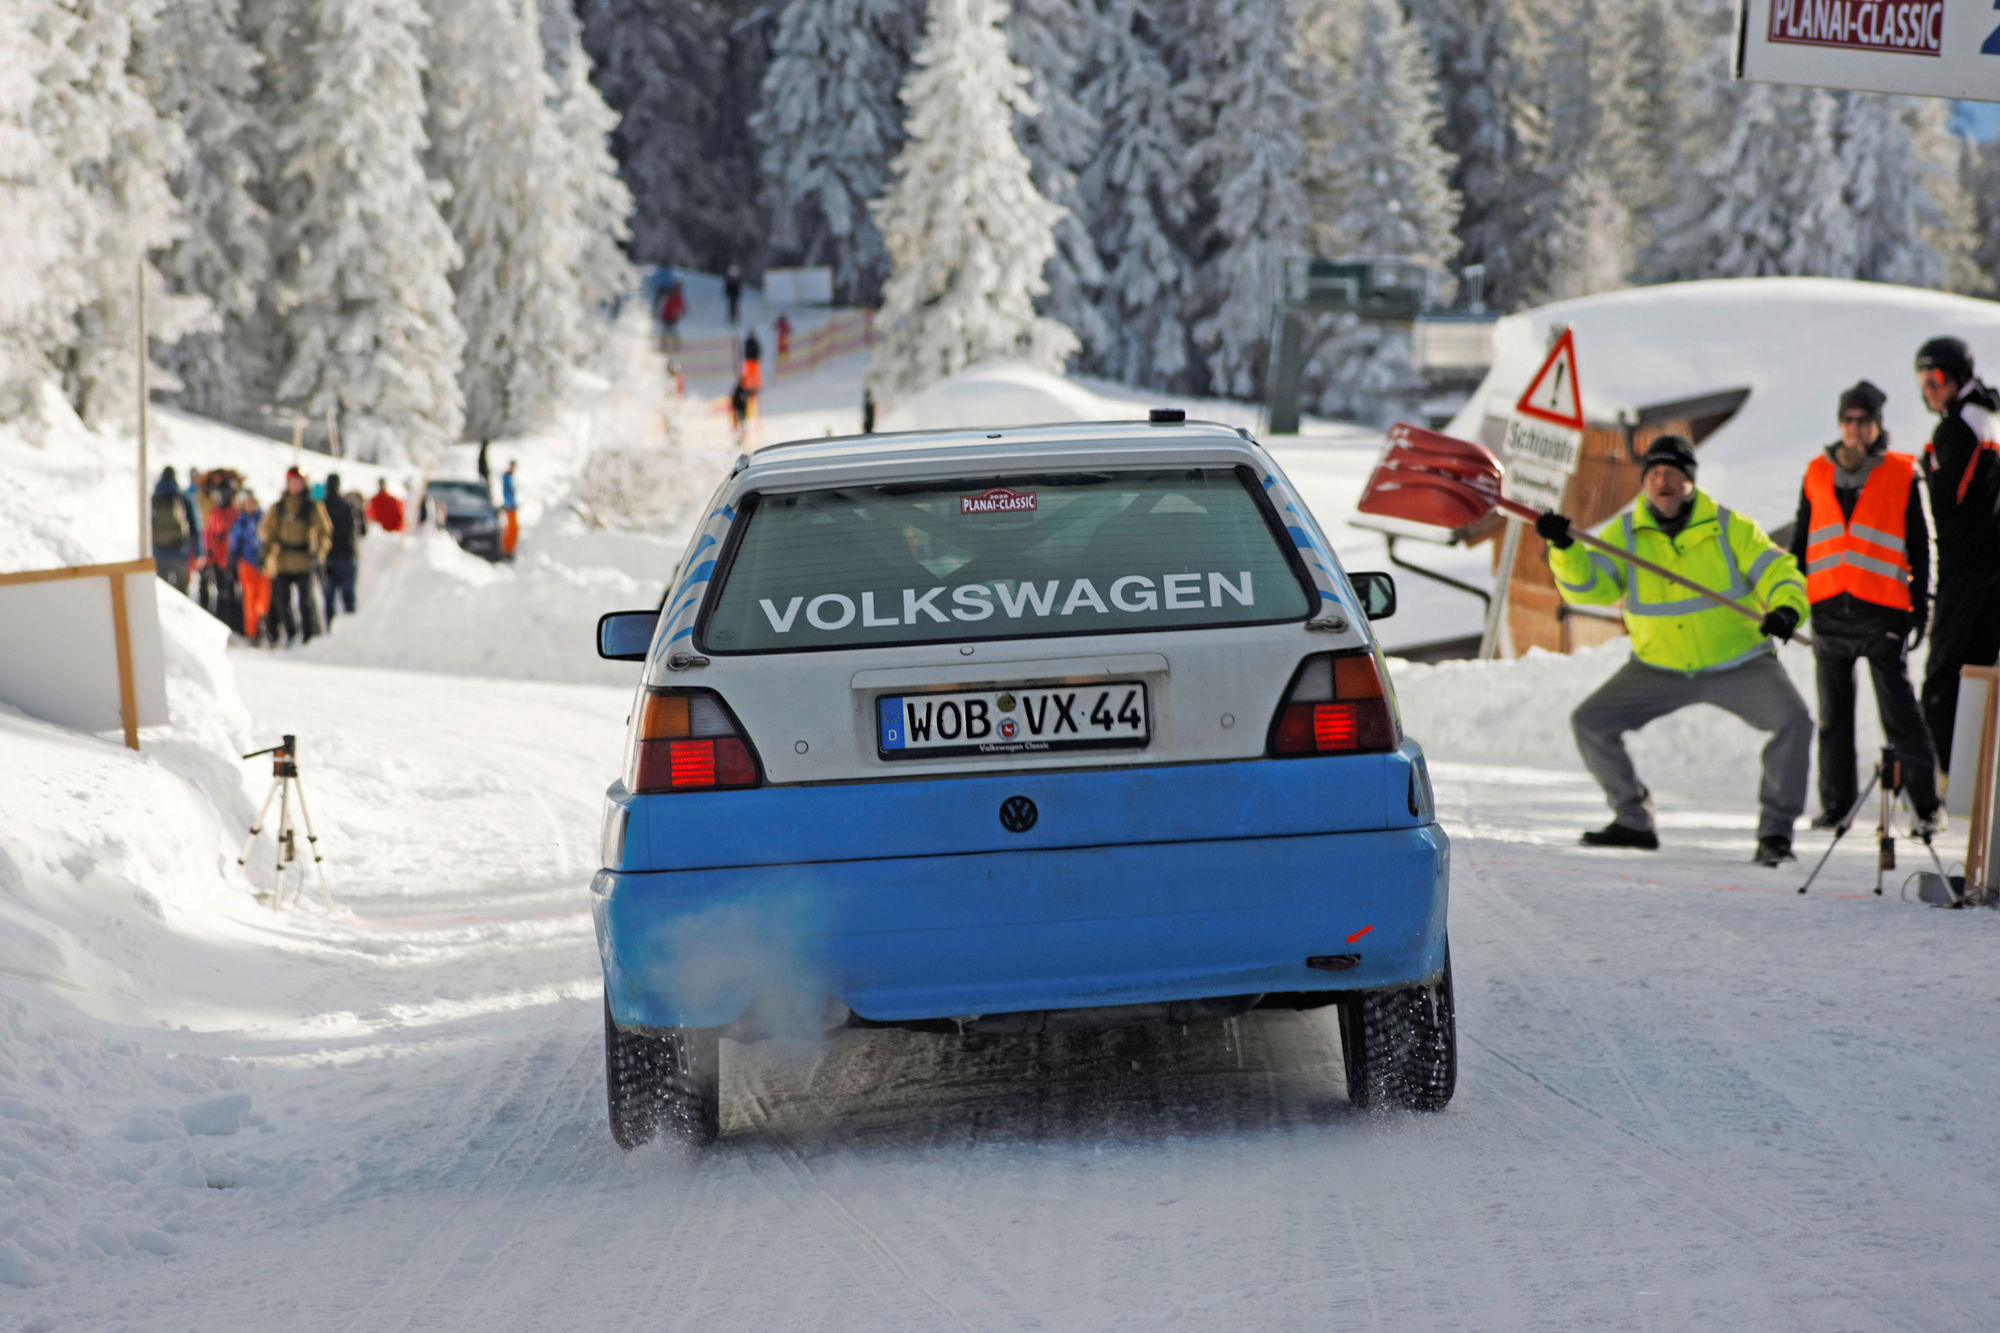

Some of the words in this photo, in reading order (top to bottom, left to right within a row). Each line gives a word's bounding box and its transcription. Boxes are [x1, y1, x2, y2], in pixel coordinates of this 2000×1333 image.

[1774, 1, 1942, 49] PLANAI-CLASSIC
[963, 495, 1034, 511] PLANAI-CLASSIC
[760, 571, 1255, 633] VOLKSWAGEN
[906, 699, 992, 741] WOB
[888, 729, 897, 741] D
[979, 743, 1024, 752] Volkswagen
